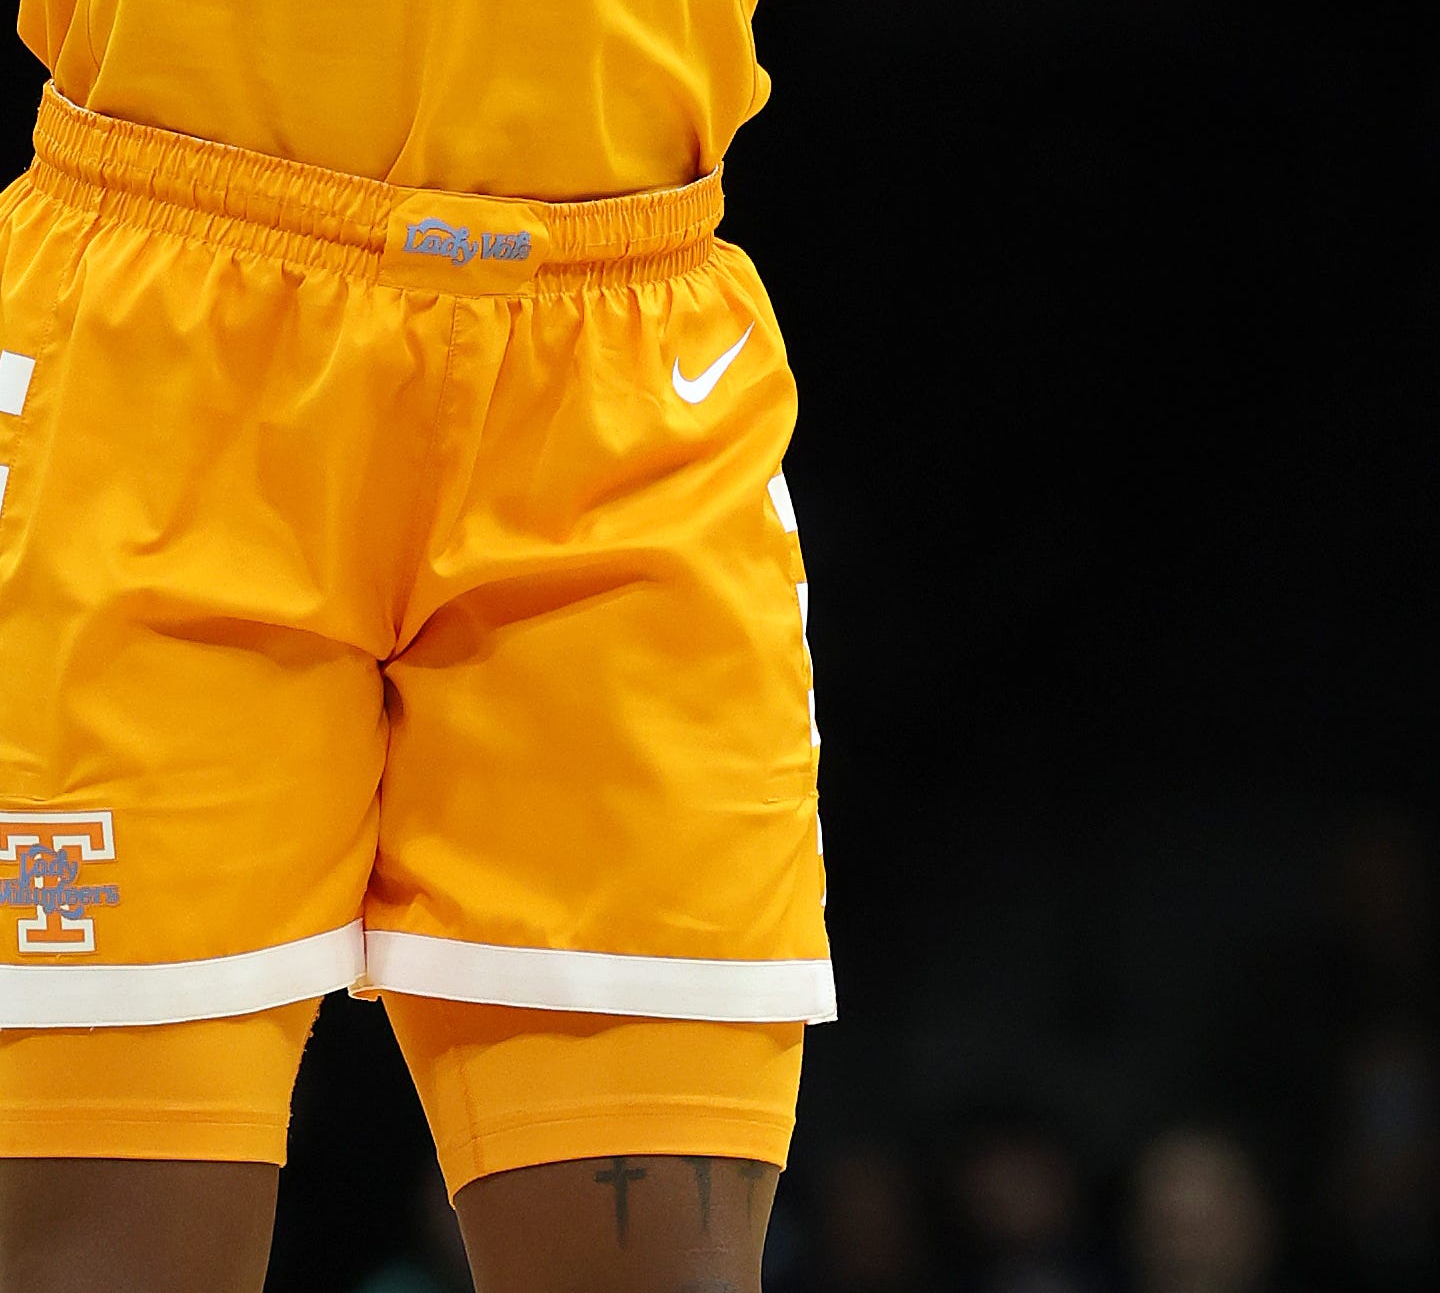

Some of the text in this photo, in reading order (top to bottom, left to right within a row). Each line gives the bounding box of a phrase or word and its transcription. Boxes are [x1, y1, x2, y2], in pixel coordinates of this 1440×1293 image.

[402, 216, 532, 267] Lady Vols
[19, 843, 79, 888] Lady
